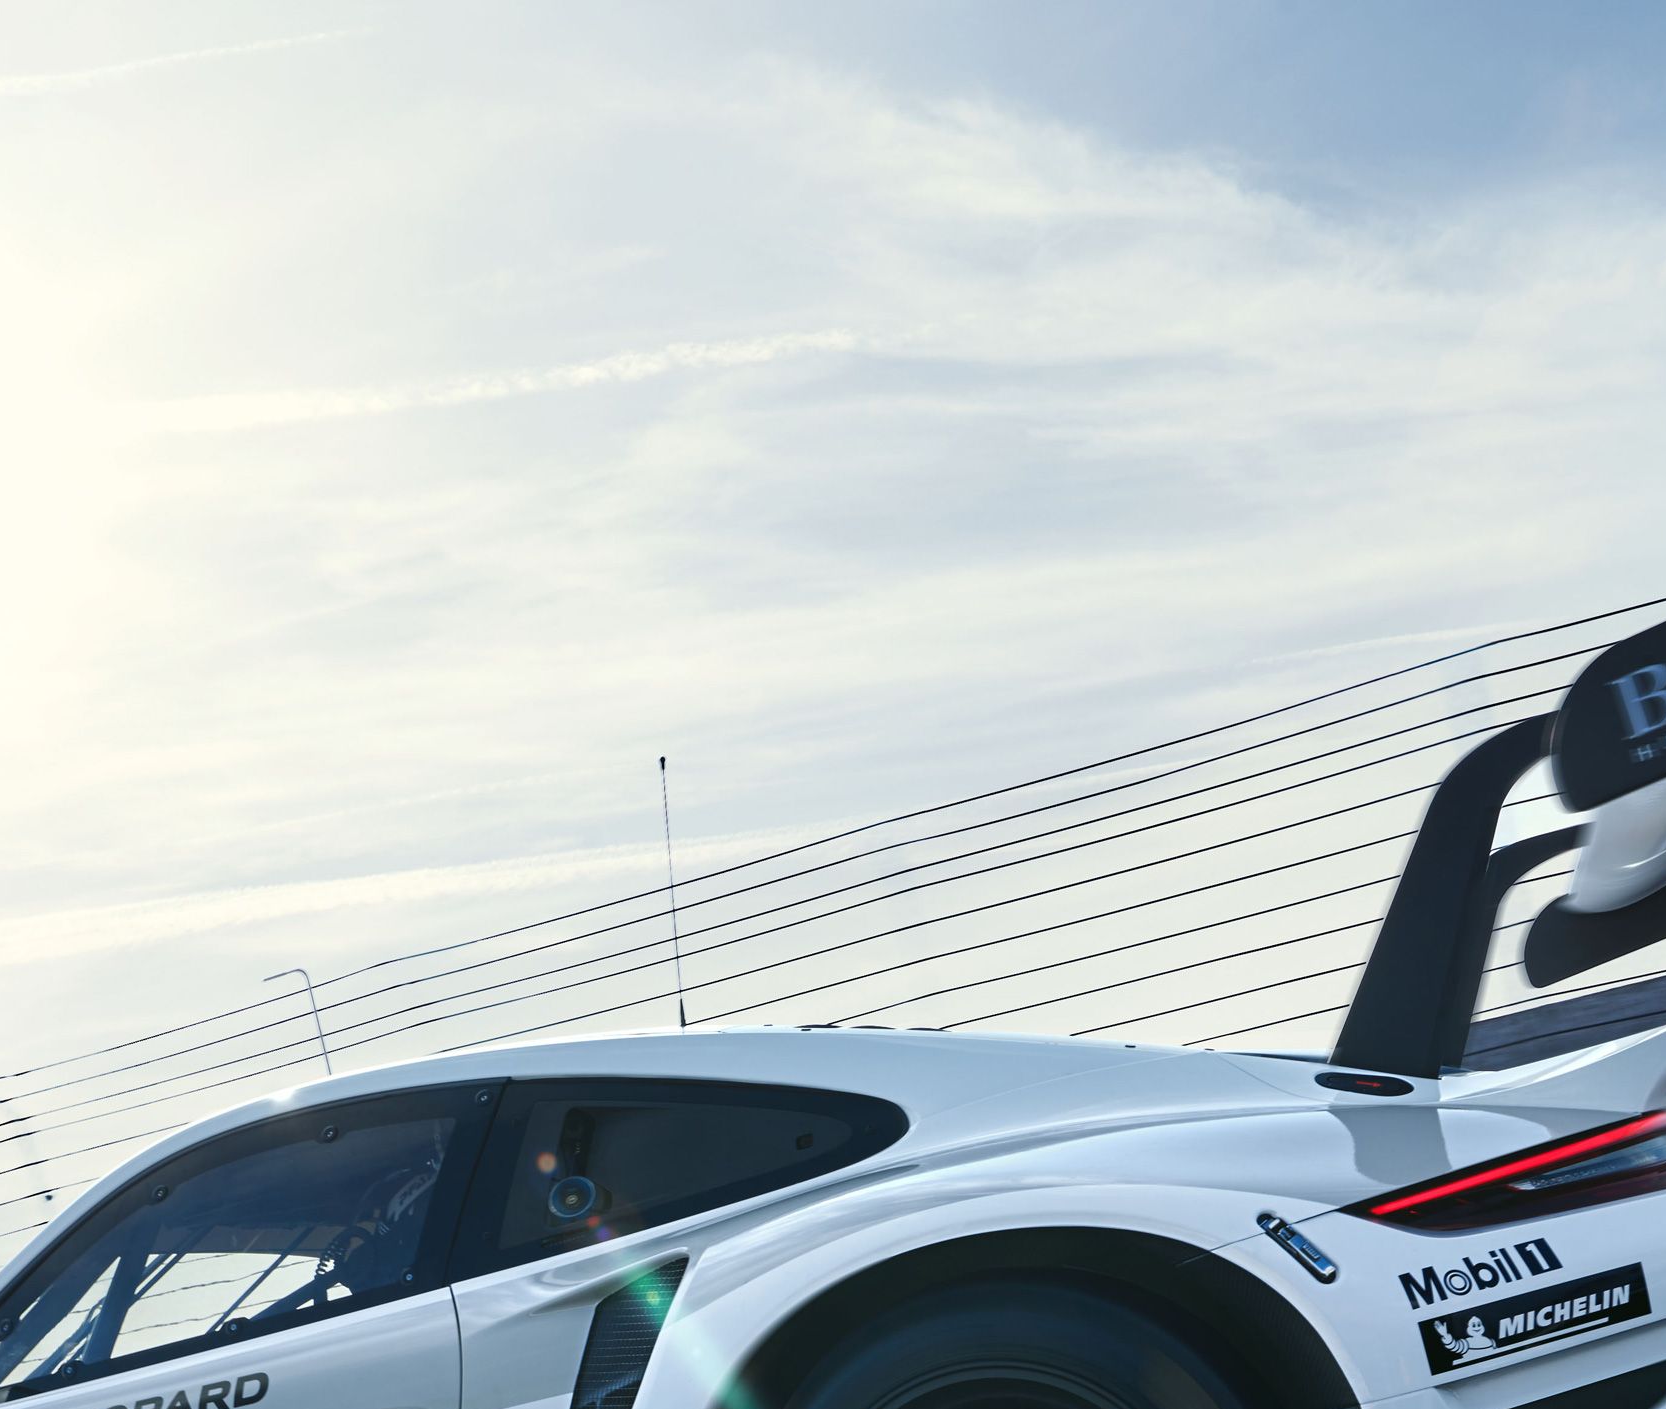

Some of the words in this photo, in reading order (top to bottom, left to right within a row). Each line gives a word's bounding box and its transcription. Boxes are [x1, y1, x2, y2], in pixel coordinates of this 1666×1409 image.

[1398, 1247, 1523, 1310] Mobil
[1522, 1241, 1554, 1272] 1
[1499, 1284, 1631, 1340] MICHELIN
